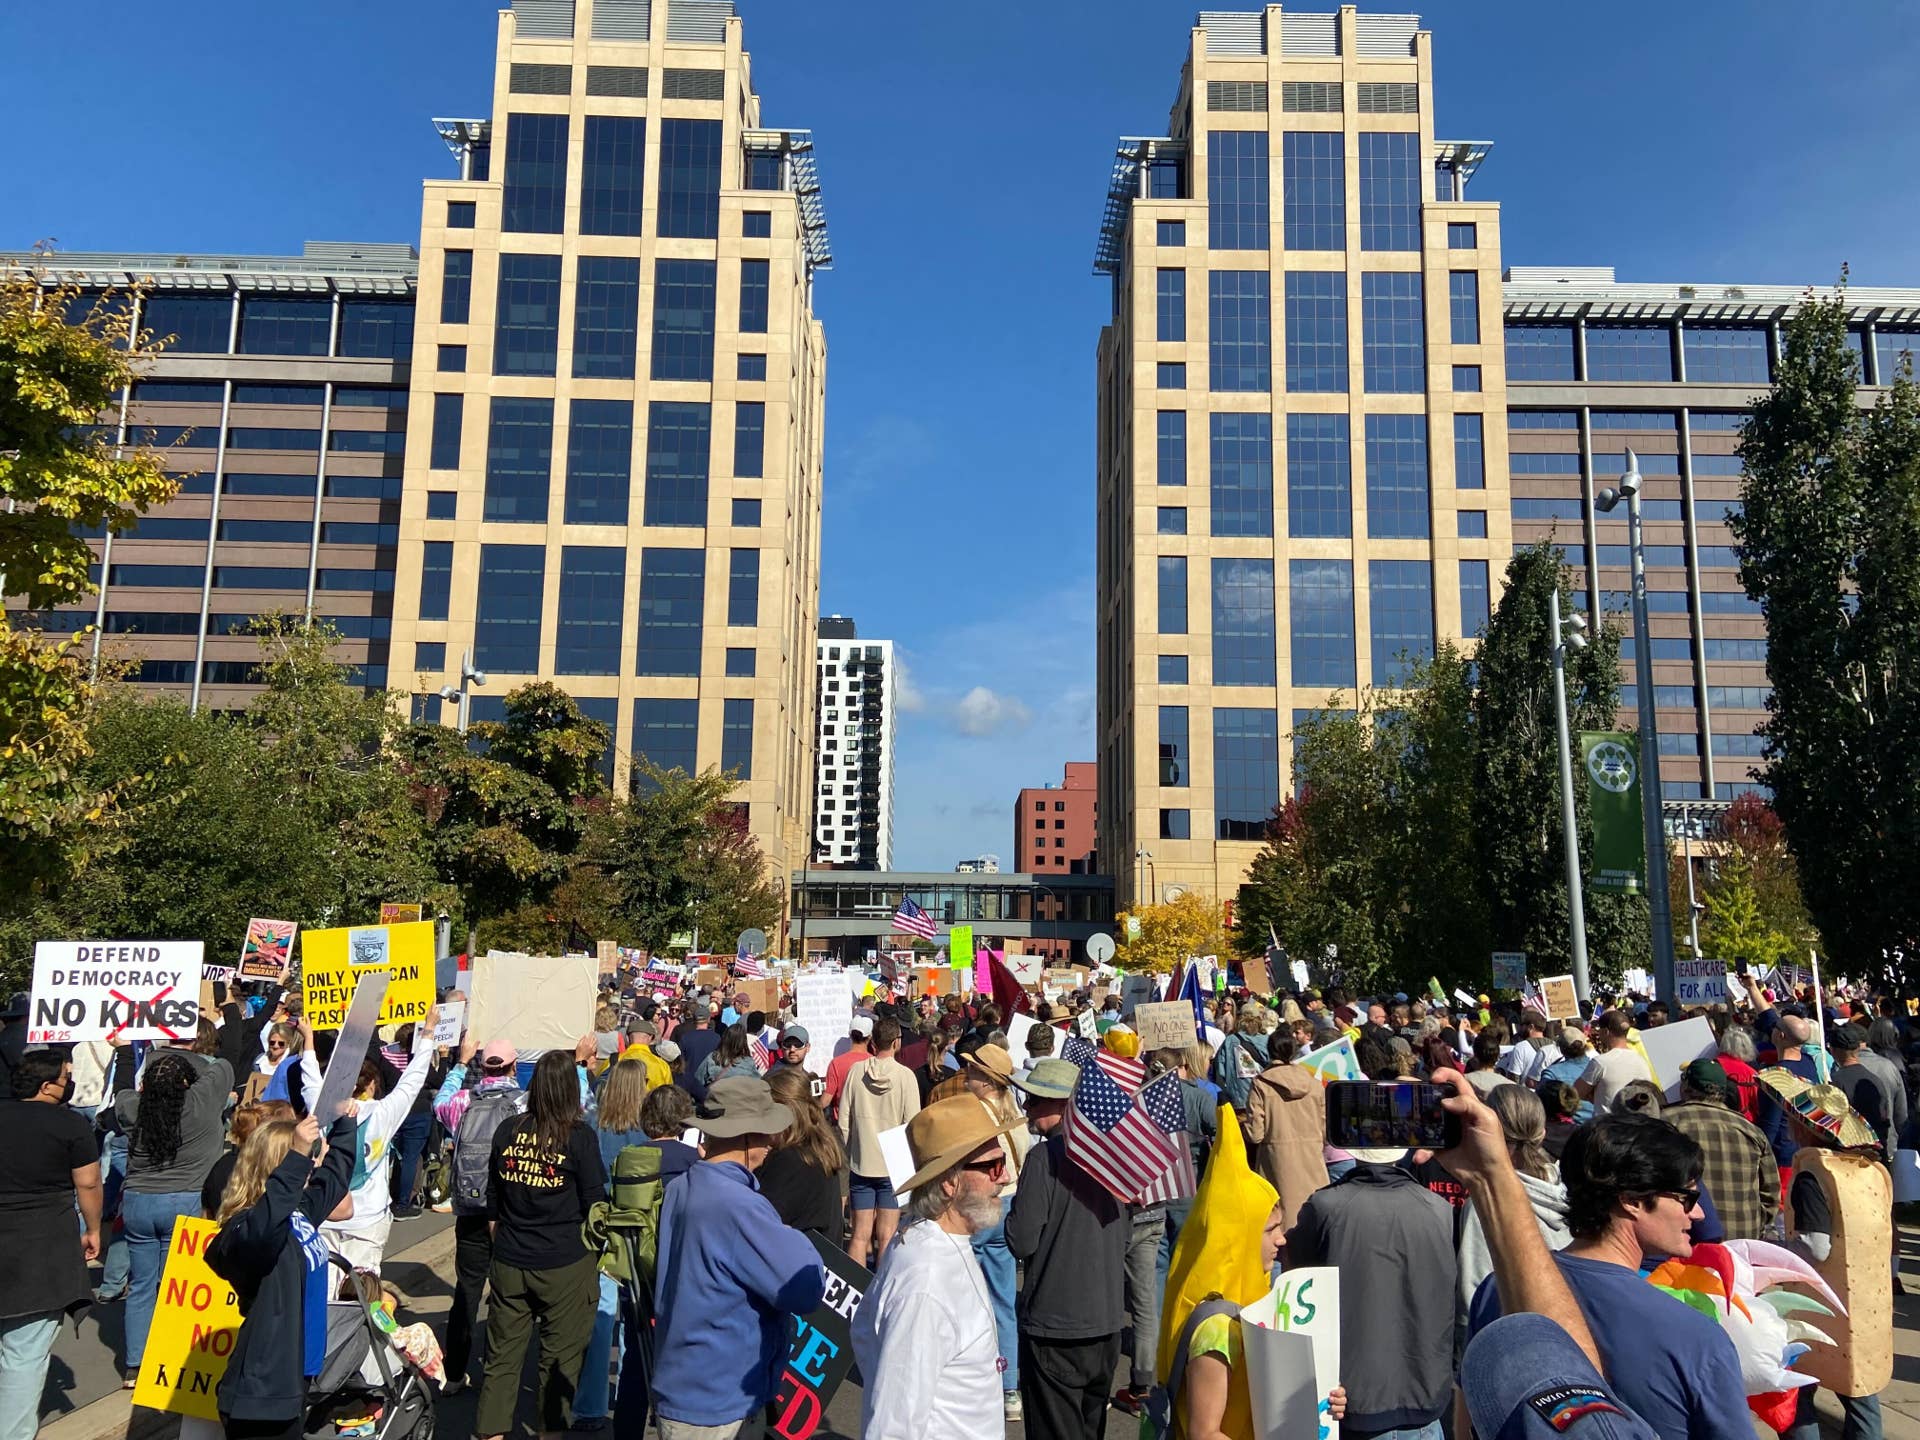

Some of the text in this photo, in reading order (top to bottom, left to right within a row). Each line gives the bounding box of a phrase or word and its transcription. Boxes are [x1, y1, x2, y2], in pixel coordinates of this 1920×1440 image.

[76, 946, 161, 963] DEFEND
[243, 966, 281, 978] IMMIGRANTS
[390, 965, 419, 982] CAN
[1674, 961, 1727, 977] HEALTHCARE
[51, 970, 182, 987] DEMOCRACY
[307, 970, 345, 988] ONLY
[1680, 983, 1699, 999] FOR
[1704, 983, 1726, 998] ALL
[35, 998, 198, 1028] NO KINGS
[308, 1009, 347, 1025] FASCI
[1153, 1020, 1189, 1033] NO ONE
[29, 1030, 72, 1042] 10.18.25
[1157, 1032, 1185, 1042] LEFT
[517, 1160, 543, 1174] THE
[499, 1170, 564, 1188] MACHINE
[1429, 1181, 1462, 1194] NEED
[165, 1277, 212, 1311] NO
[822, 1265, 864, 1322] ER
[190, 1323, 233, 1357] NO
[154, 1363, 220, 1396] KIN
[774, 1370, 822, 1440] D
[1535, 1391, 1566, 1407] UTAH
